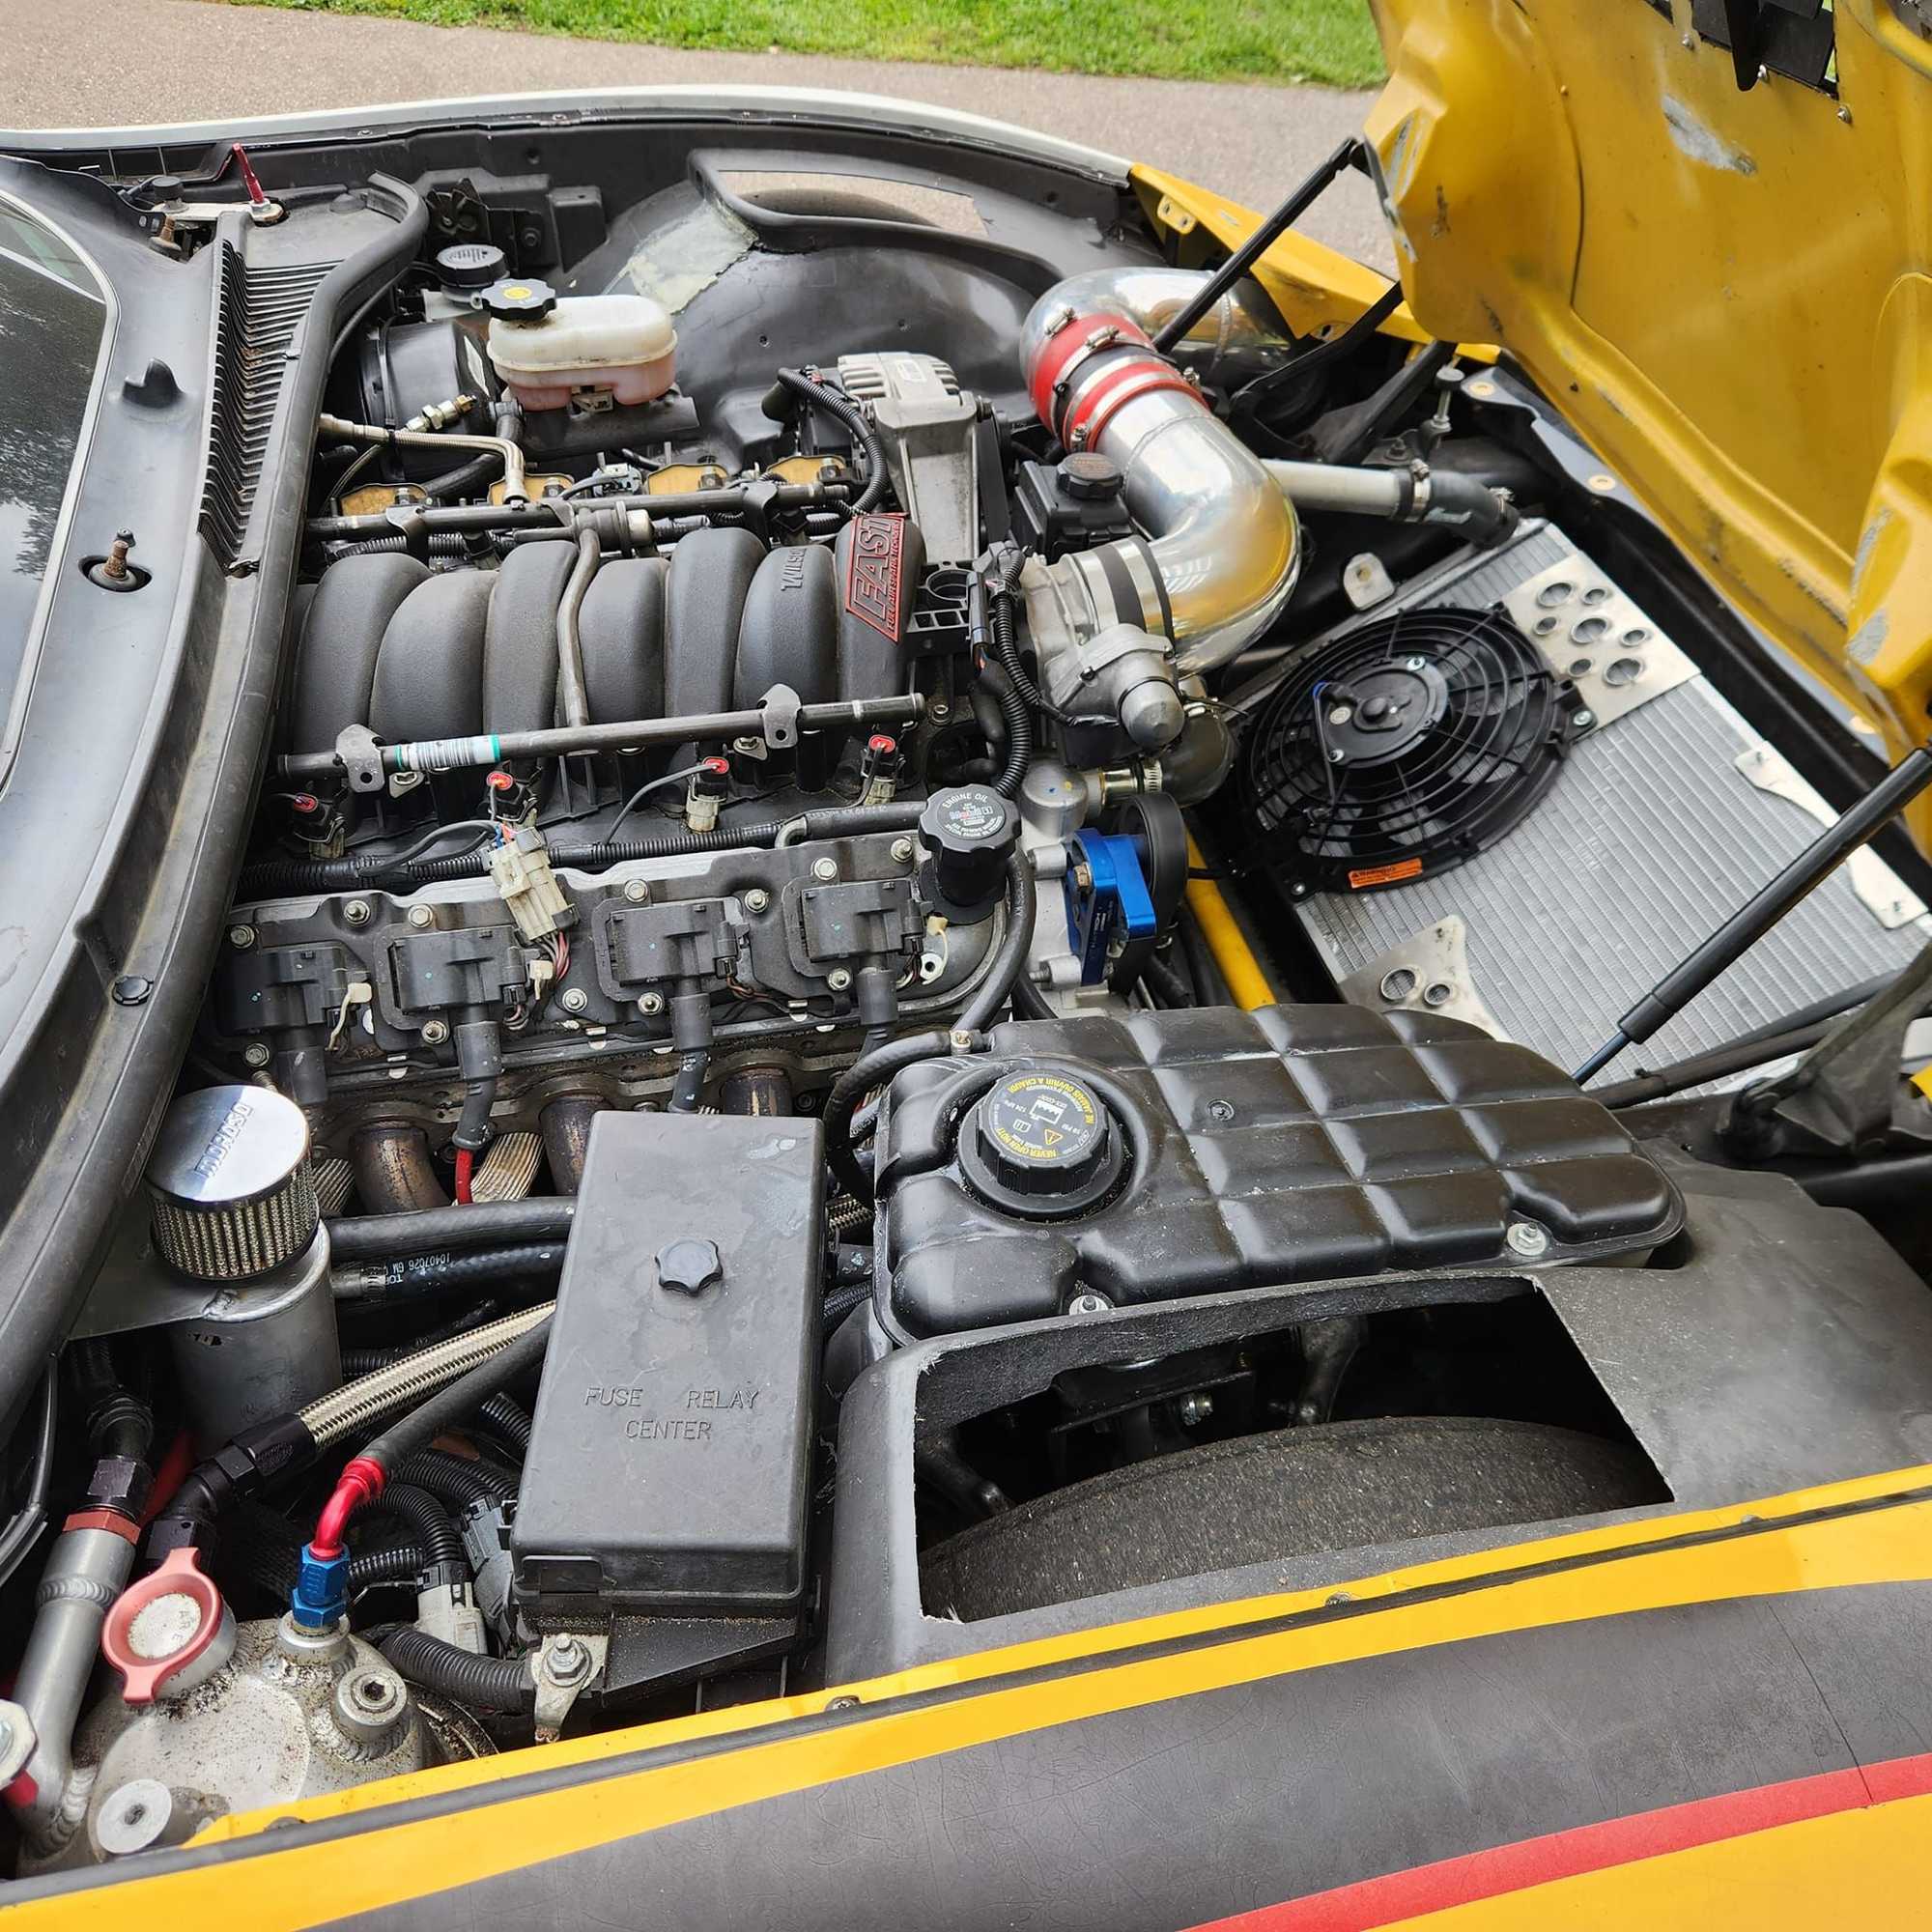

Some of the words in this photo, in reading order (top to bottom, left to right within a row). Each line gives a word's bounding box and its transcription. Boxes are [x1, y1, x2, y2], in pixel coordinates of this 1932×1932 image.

[853, 517, 892, 621] FAST
[975, 793, 988, 803] OIL
[392, 1262, 404, 1273] GM
[409, 1253, 449, 1270] 10407026
[585, 1387, 643, 1407] FUSE
[687, 1390, 759, 1409] RELAY
[626, 1420, 711, 1439] CENTER
